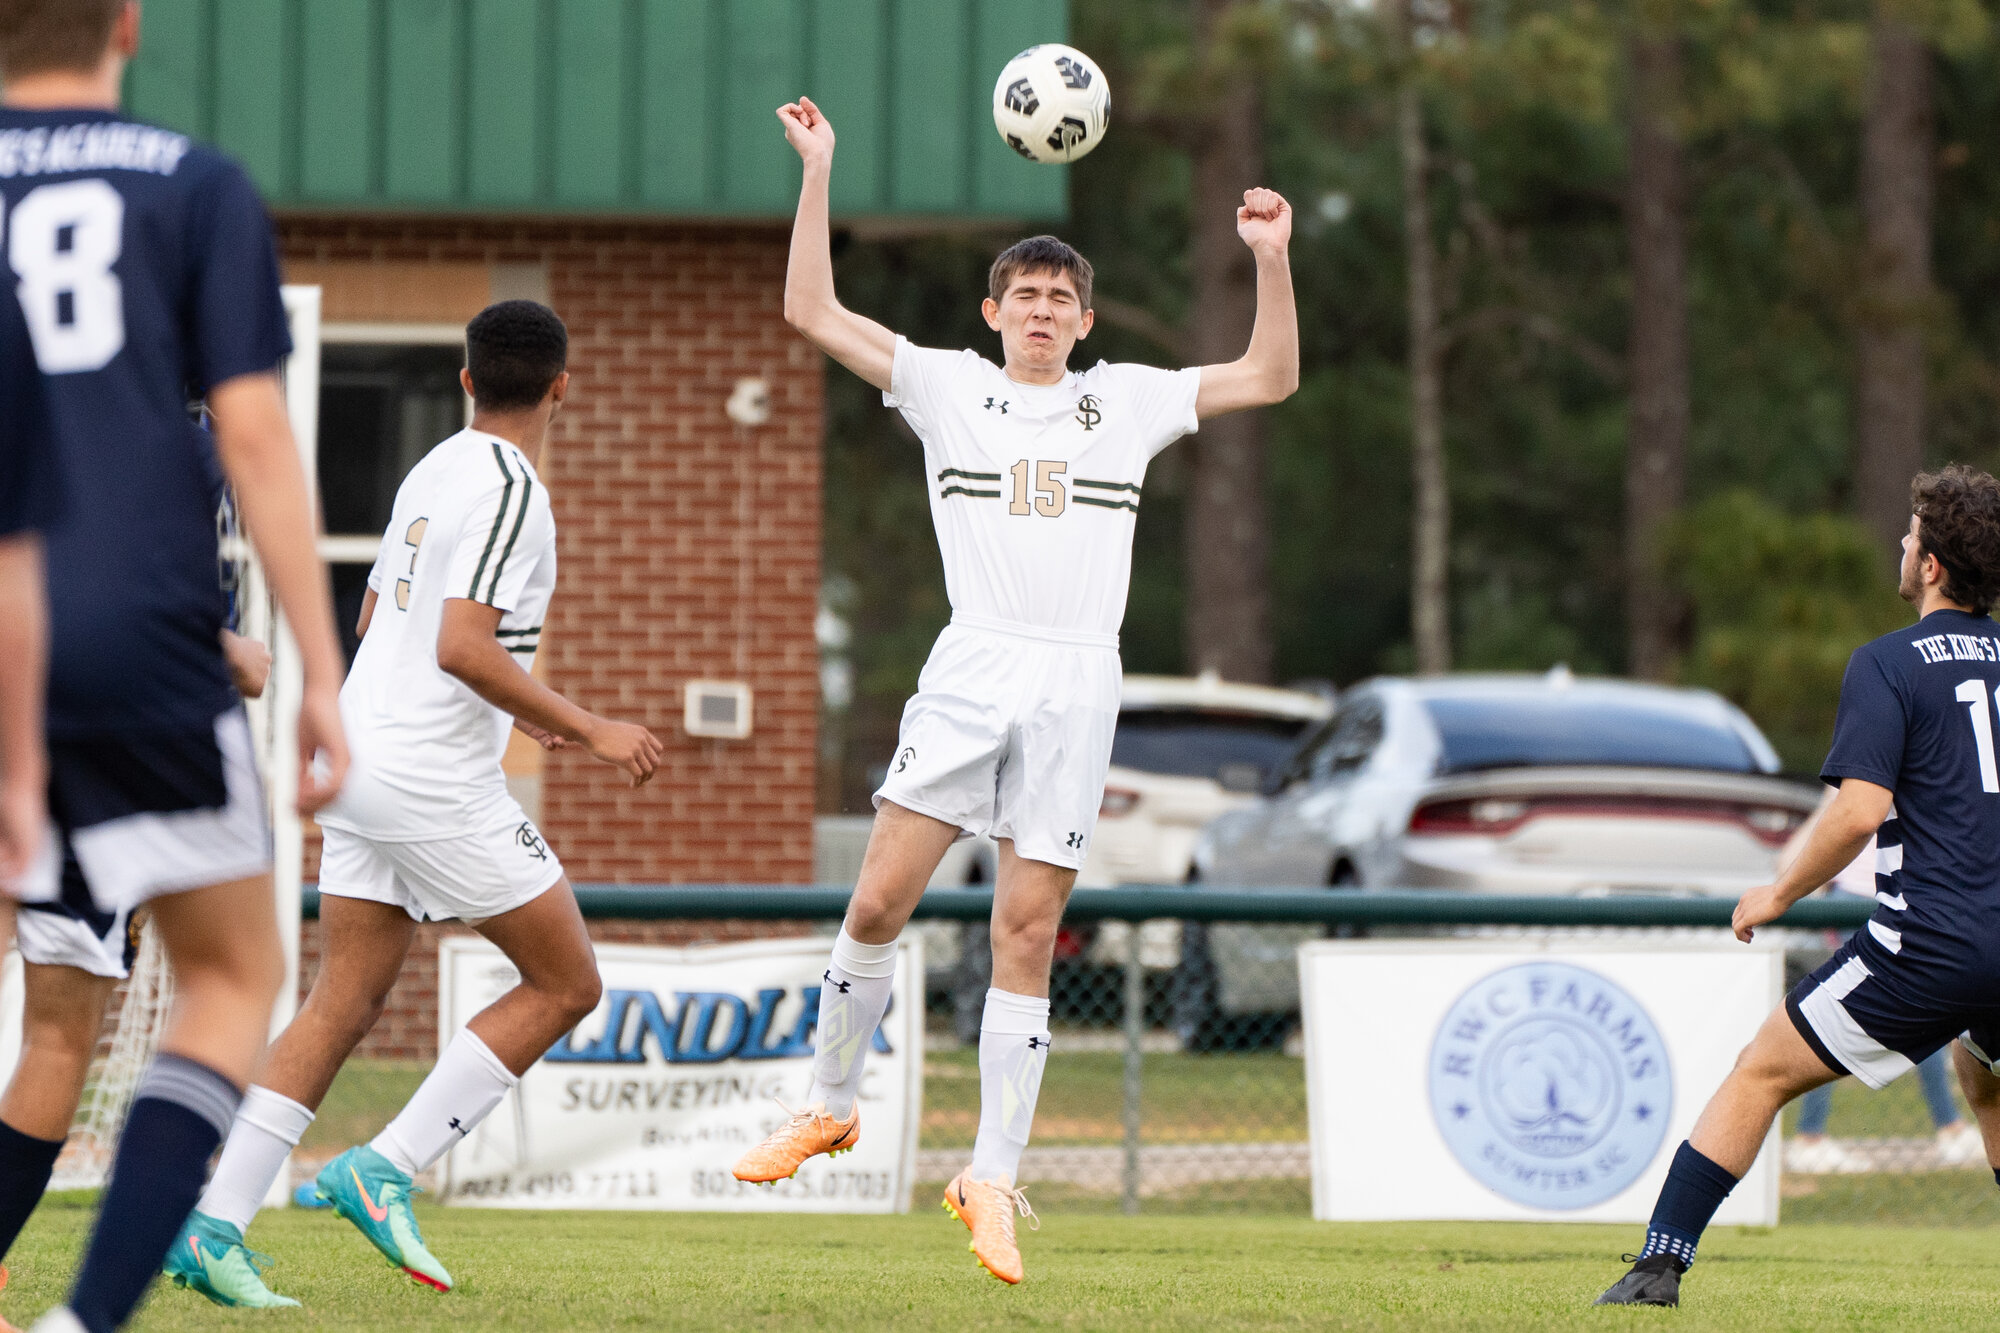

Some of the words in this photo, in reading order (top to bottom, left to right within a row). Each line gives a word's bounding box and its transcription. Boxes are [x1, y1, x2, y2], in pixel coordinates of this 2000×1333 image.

[0, 176, 126, 376] 8
[1009, 458, 1068, 518] 15
[1911, 634, 1953, 664] THE
[1945, 633, 1997, 662] KING'S
[1954, 679, 2000, 793] 1
[1528, 976, 1658, 1080] FARMS
[690, 1167, 890, 1198] 803.5.0703
